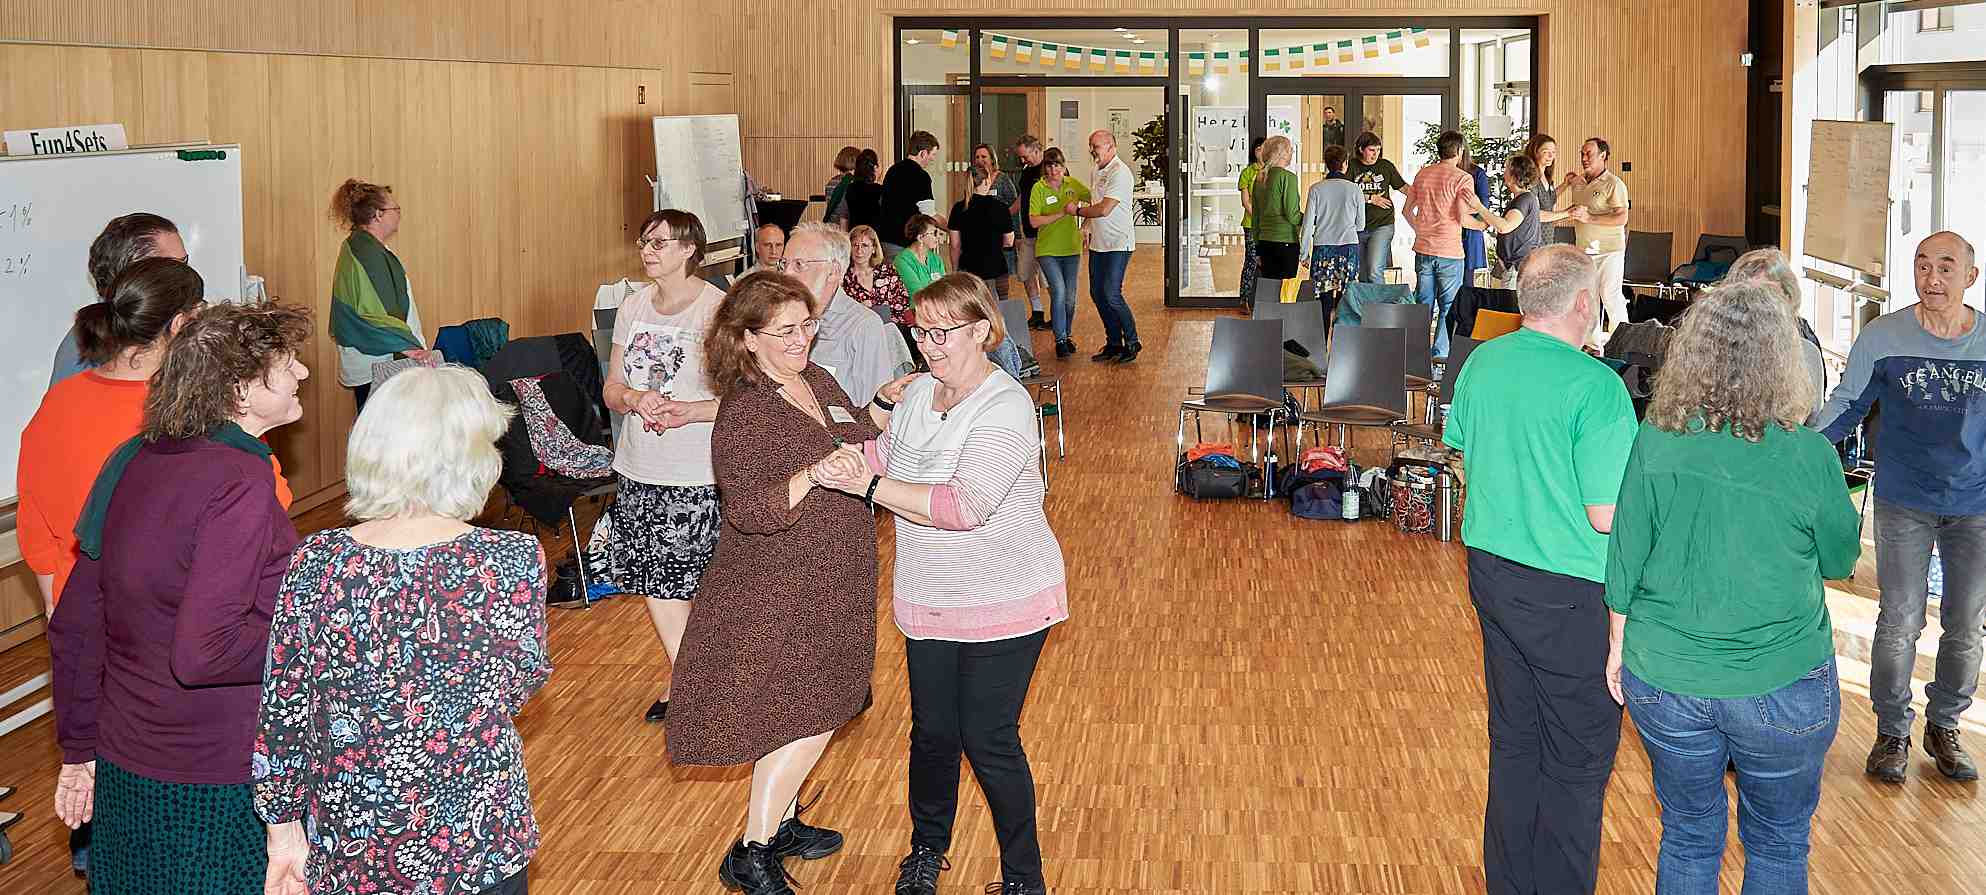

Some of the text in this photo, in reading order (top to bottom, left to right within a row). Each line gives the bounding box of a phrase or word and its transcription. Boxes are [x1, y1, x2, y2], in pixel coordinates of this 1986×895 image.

[1198, 115, 1276, 129] Herzlh
[30, 129, 108, 155] Fun4Sets
[1359, 182, 1382, 191] ORK
